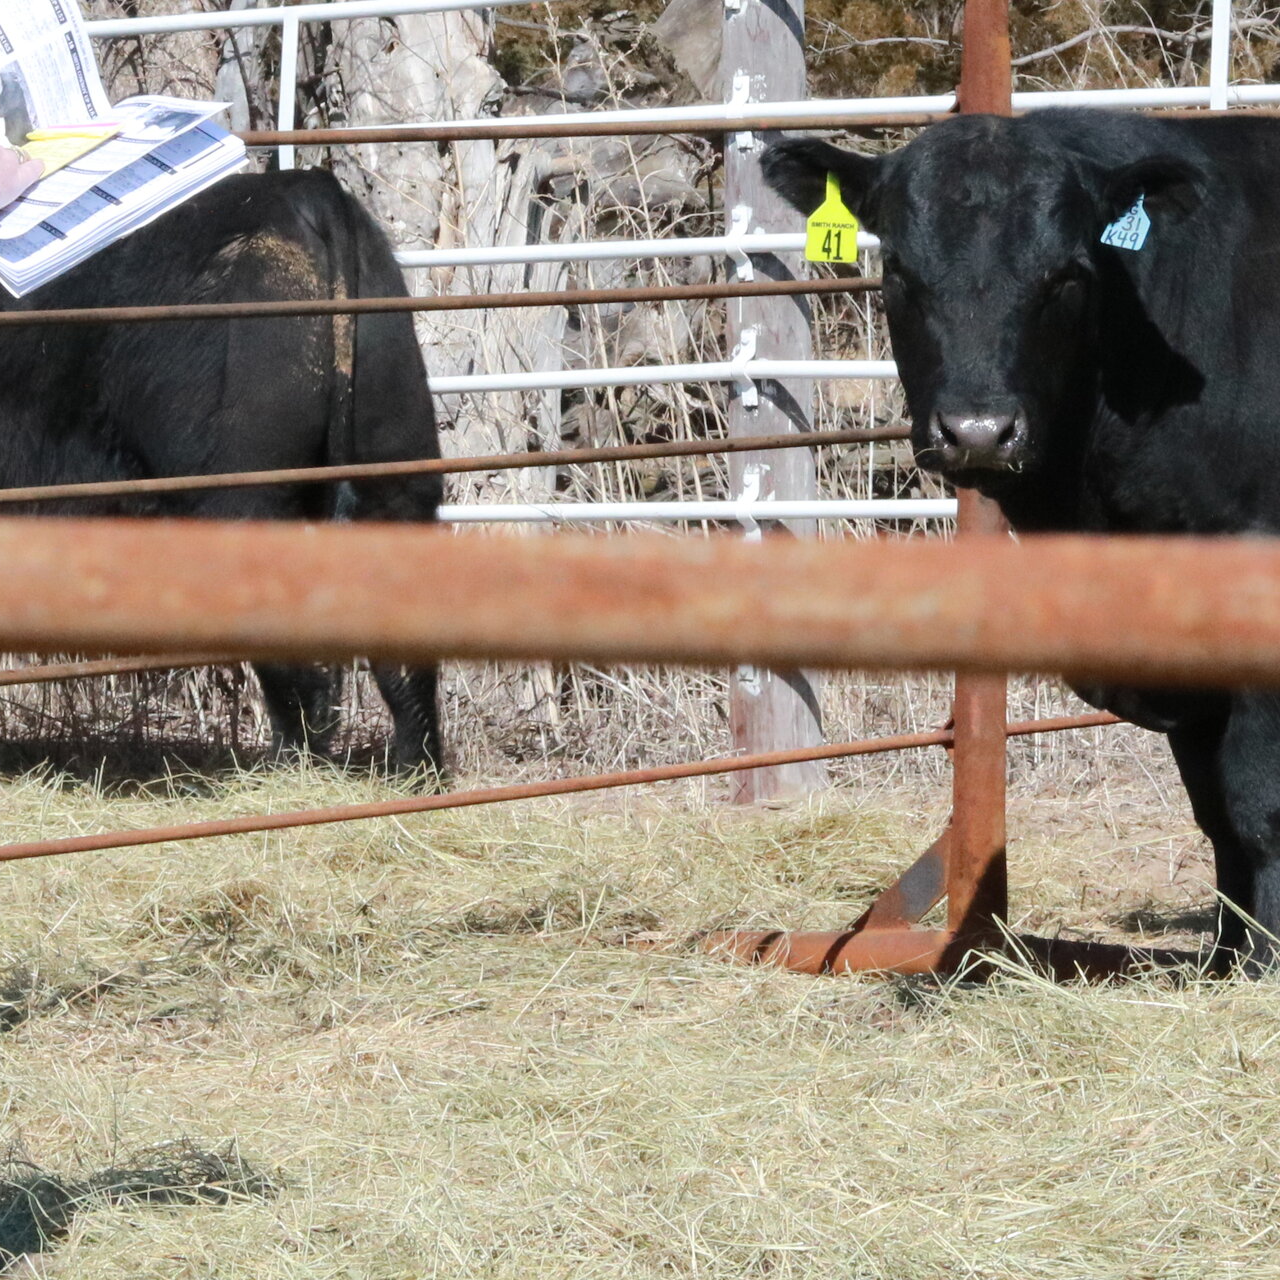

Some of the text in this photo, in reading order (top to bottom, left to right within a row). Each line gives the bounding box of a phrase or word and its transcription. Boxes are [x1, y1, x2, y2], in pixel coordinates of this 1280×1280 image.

[831, 222, 855, 230] RANCH
[1121, 216, 1142, 232] 31
[822, 229, 843, 261] 41
[1104, 228, 1140, 250] K49
